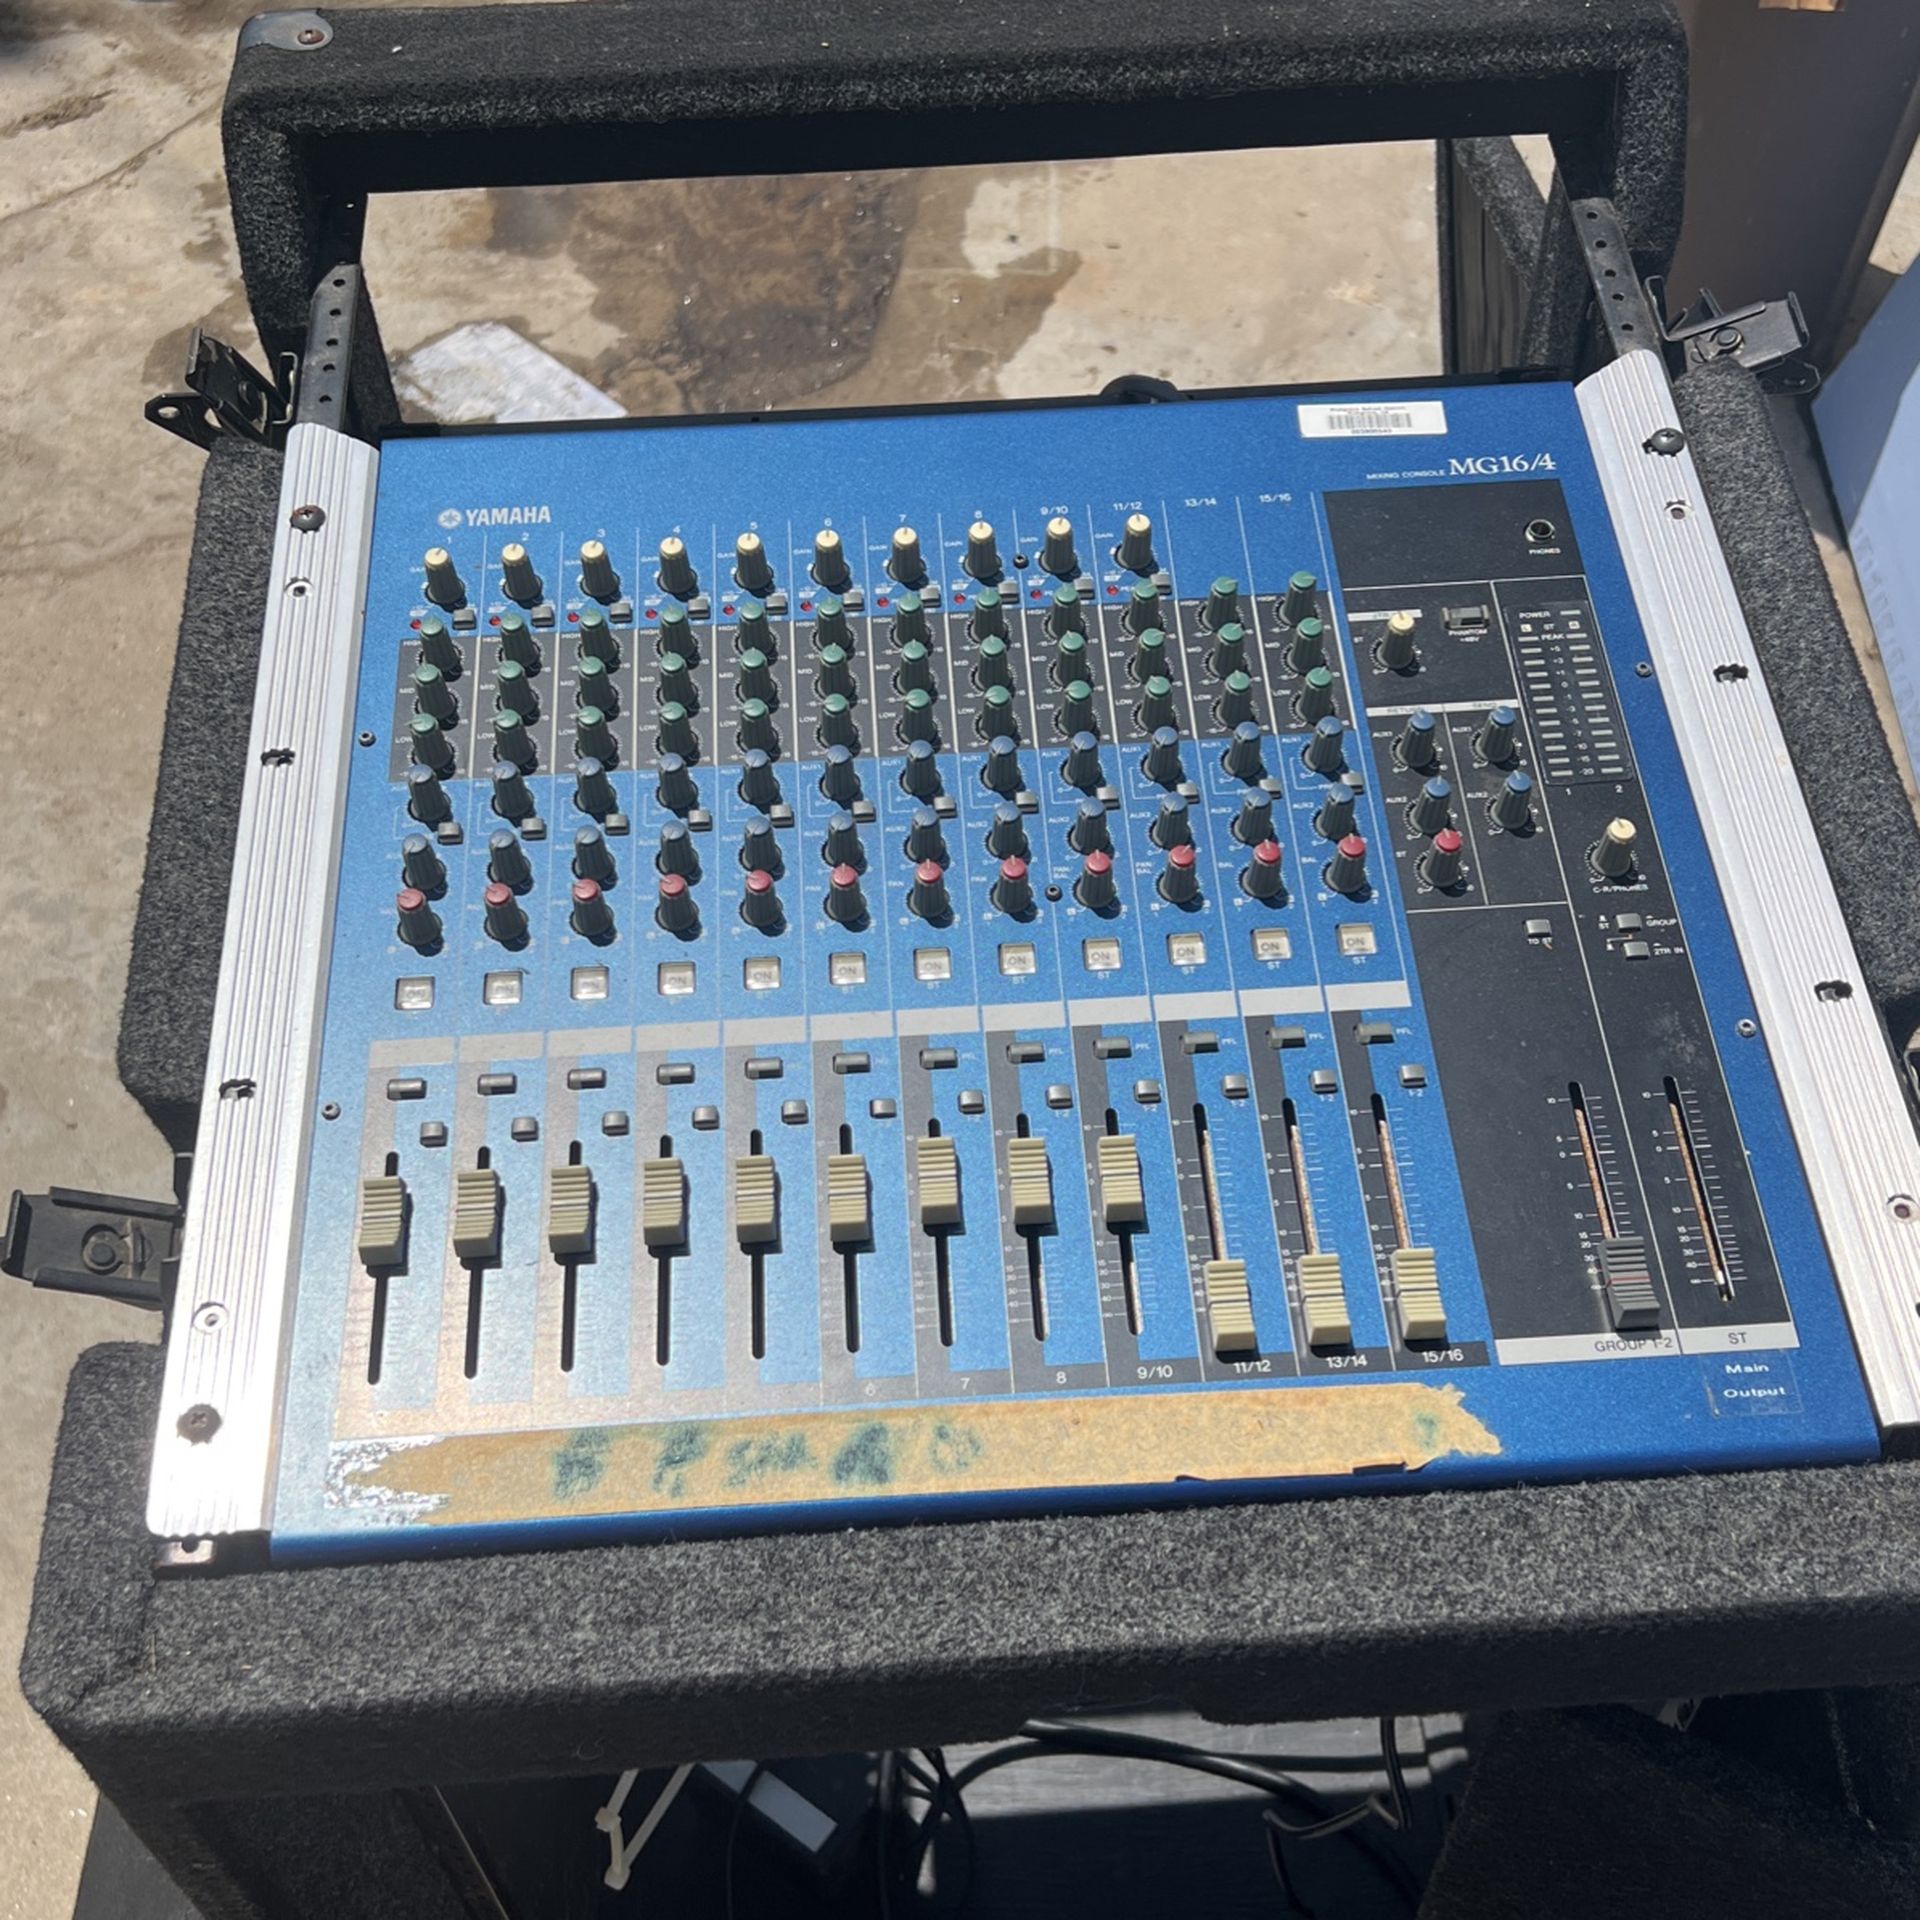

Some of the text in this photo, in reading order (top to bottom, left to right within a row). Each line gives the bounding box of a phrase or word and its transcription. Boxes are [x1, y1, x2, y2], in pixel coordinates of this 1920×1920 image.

[1366, 453, 1557, 481] MIXING CONSOLE MG16/4
[1185, 498, 1217, 507] 13/14
[1259, 493, 1292, 503] 15/16
[1040, 505, 1069, 516] 9/10
[1113, 502, 1143, 511] 11/12
[465, 505, 551, 527] YAMAHA
[1519, 611, 1550, 619] POWER
[1646, 918, 1677, 926] GROUP
[1260, 941, 1280, 952] ON
[1345, 937, 1366, 947] ON
[1090, 951, 1110, 962] ON
[1176, 946, 1196, 957] ON
[923, 961, 943, 971] ON
[1007, 955, 1027, 966] ON
[753, 971, 773, 982] ON
[838, 966, 857, 976] ON
[668, 975, 687, 985] ON
[1728, 1332, 1747, 1345] ST
[1594, 1338, 1647, 1352] GROUP
[1422, 1349, 1464, 1363] 15/16
[1233, 1359, 1272, 1374] 11/12
[1326, 1355, 1368, 1369] 13/14
[1137, 1365, 1173, 1380] 9/10
[1725, 1363, 1770, 1374] Main
[1055, 1371, 1067, 1384] 8
[960, 1377, 970, 1390] 7
[1723, 1386, 1786, 1398] Output
